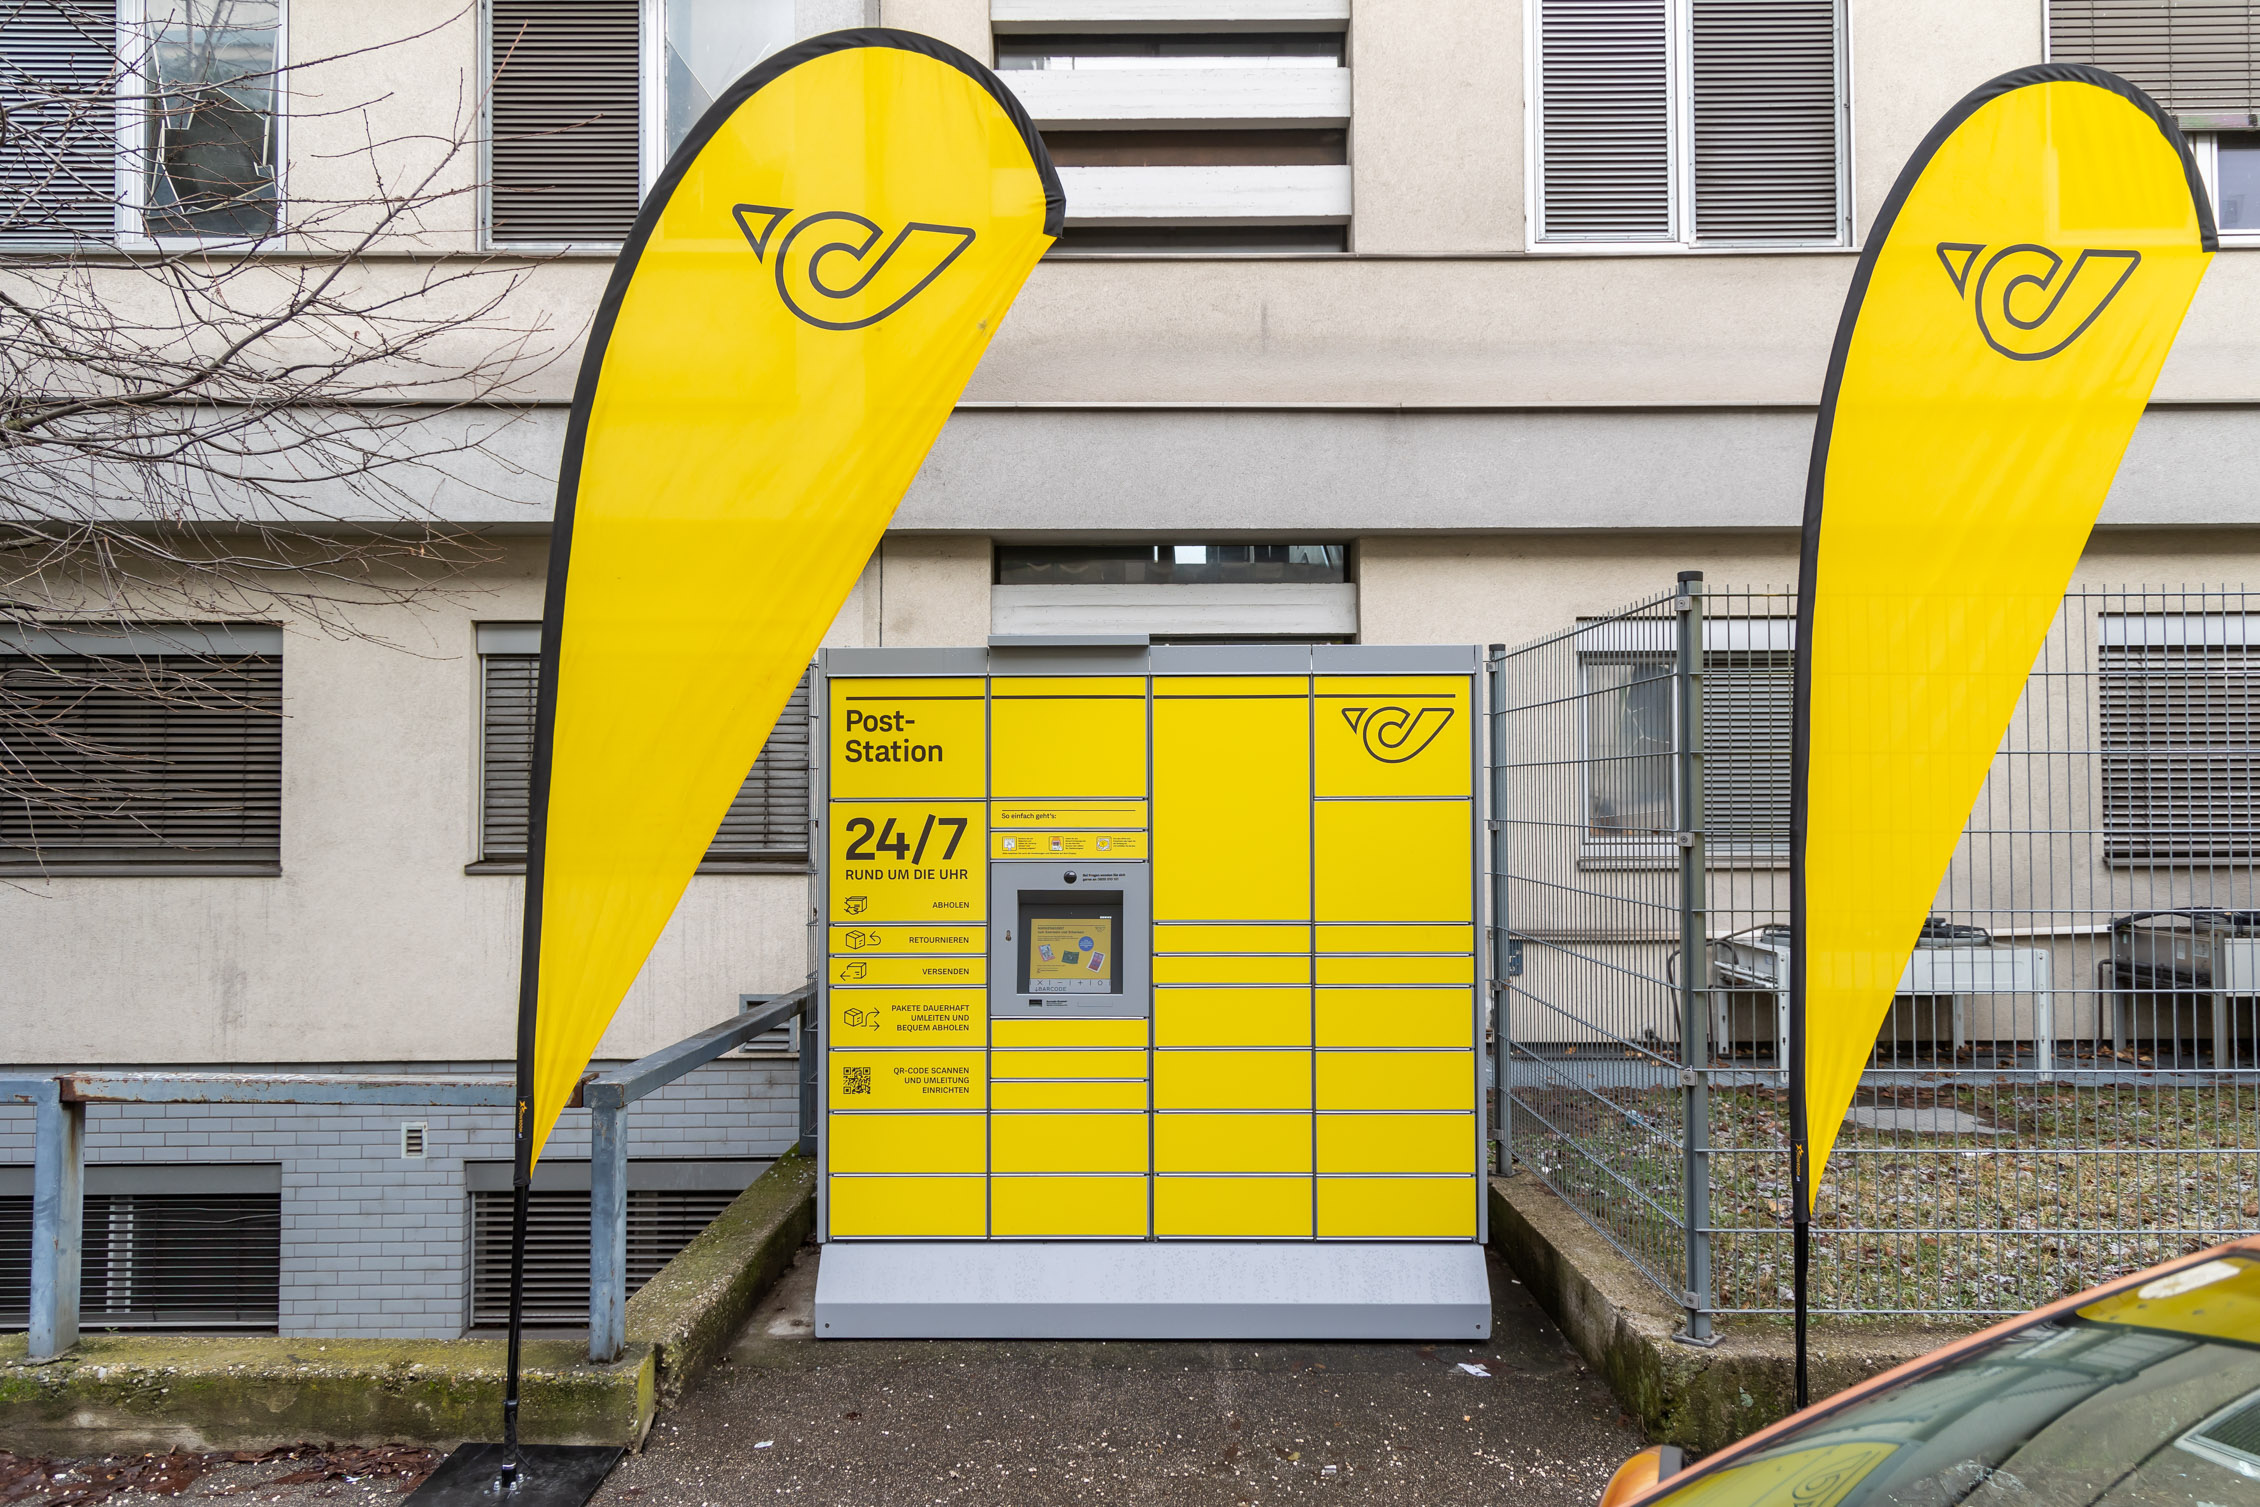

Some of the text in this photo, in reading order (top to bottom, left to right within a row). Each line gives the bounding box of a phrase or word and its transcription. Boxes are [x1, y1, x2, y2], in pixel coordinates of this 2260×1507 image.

[846, 709, 915, 733] Post-
[845, 738, 943, 763] Station
[1035, 812, 1057, 820] geht's:
[845, 813, 968, 866] 24/7
[845, 868, 968, 881] RUND UM DIE UHR
[932, 901, 970, 909] ABHOLEN
[909, 936, 970, 944] RETOURNIEREN
[922, 967, 970, 975] VERSENDEN
[891, 1004, 970, 1012] PAKETE DAUERHAFT
[911, 1014, 970, 1022] UMLEITEN UND
[896, 1024, 970, 1033] BEQUEM ABHOLEN
[893, 1067, 970, 1075] QR-CODE SCANNEN
[923, 1076, 970, 1084] UMLEITUNG
[922, 1086, 970, 1094] EINRICHTEN
